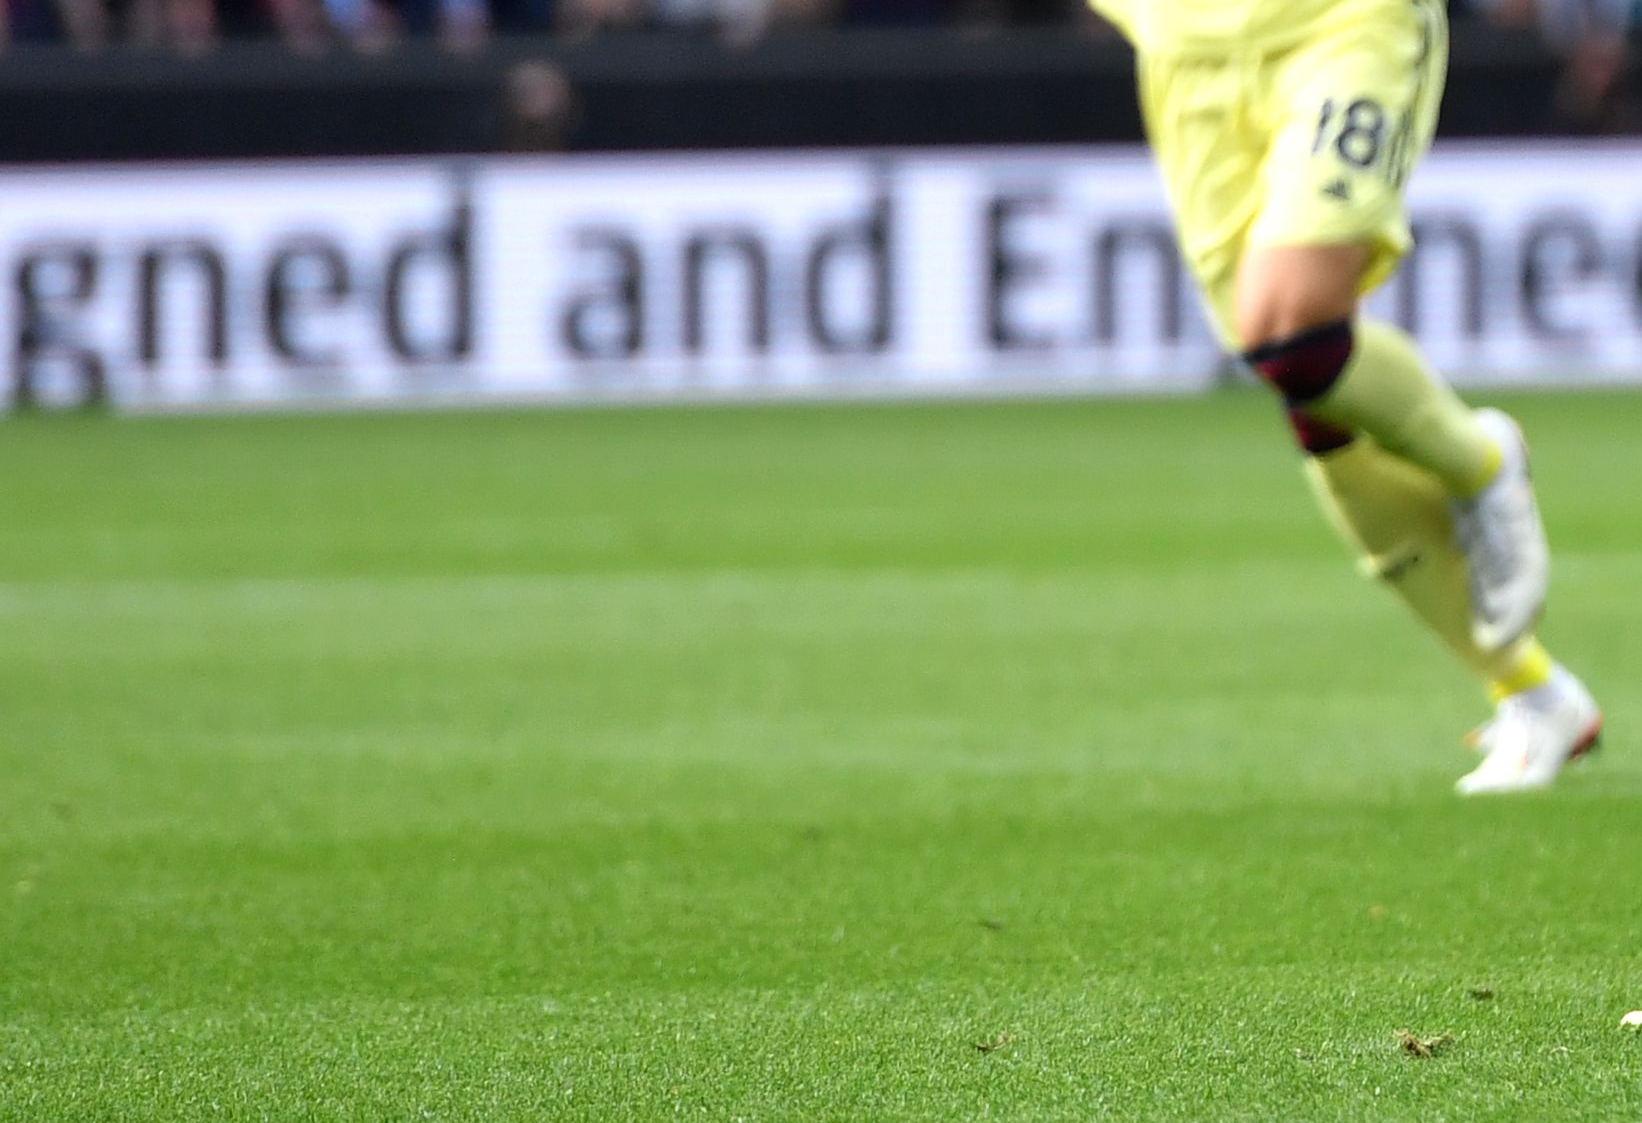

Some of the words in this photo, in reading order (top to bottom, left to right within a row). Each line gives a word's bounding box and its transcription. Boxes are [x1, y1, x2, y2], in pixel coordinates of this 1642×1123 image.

[1311, 97, 1385, 170] 18
[14, 174, 473, 409] gned
[560, 167, 892, 357] and
